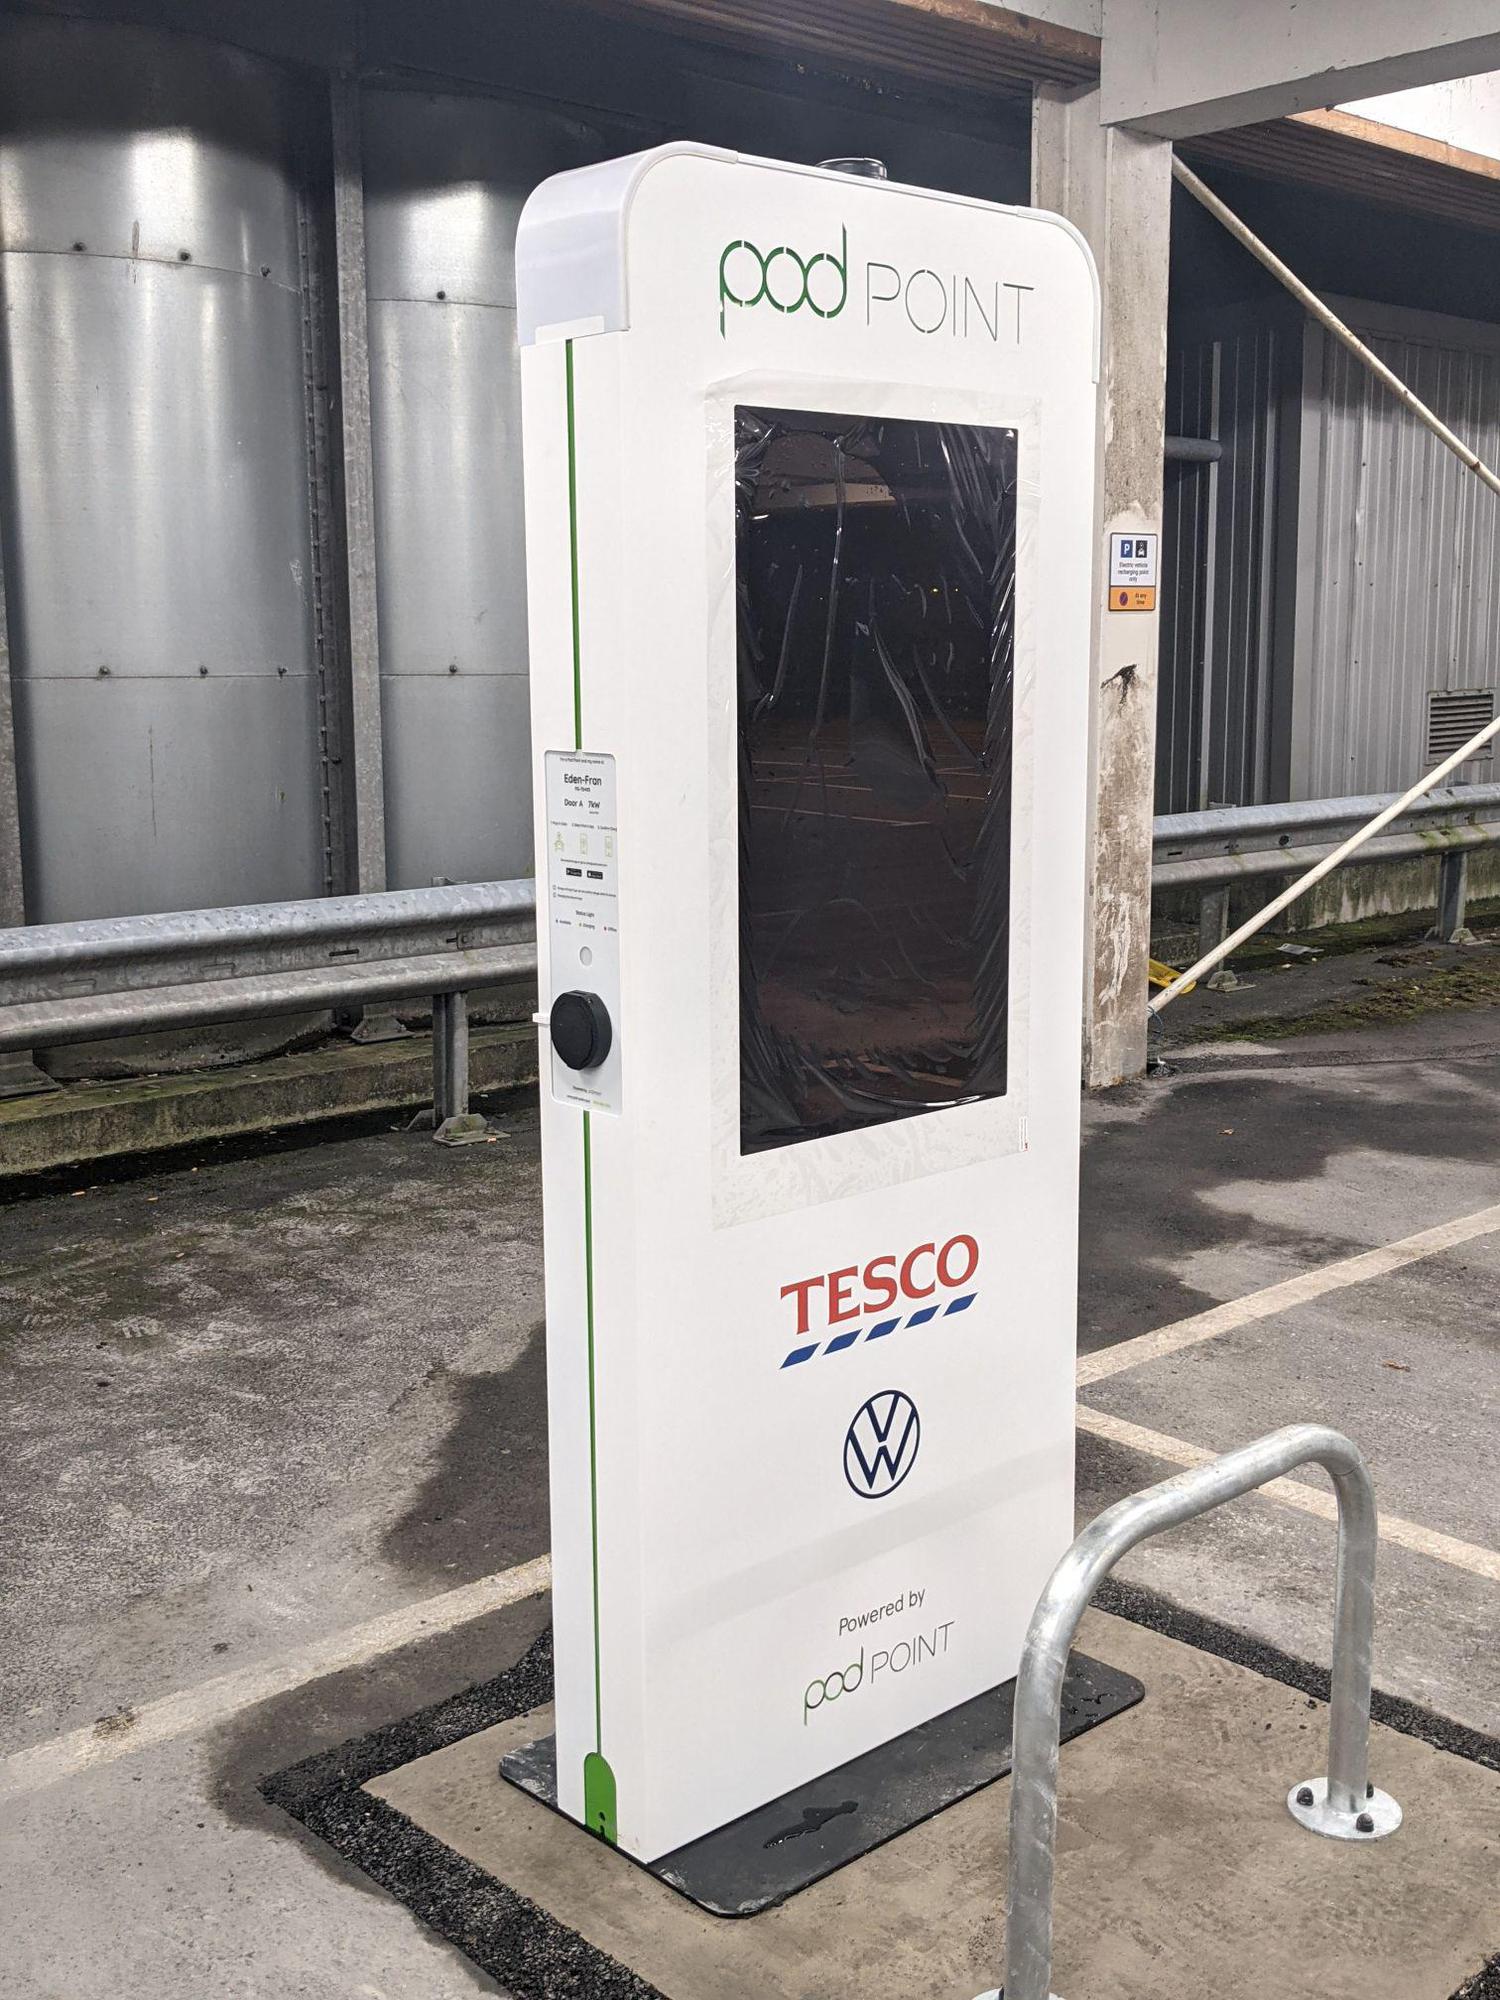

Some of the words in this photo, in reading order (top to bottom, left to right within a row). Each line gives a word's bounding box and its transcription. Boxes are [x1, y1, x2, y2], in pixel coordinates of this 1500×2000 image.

[866, 261, 1035, 345] POINT
[564, 774, 602, 786] Eden-Fran
[564, 798, 578, 807] Door
[780, 1234, 979, 1335] TESCO
[838, 1593, 904, 1637] Powered
[908, 1588, 926, 1608] by
[870, 1620, 956, 1684] POINT
